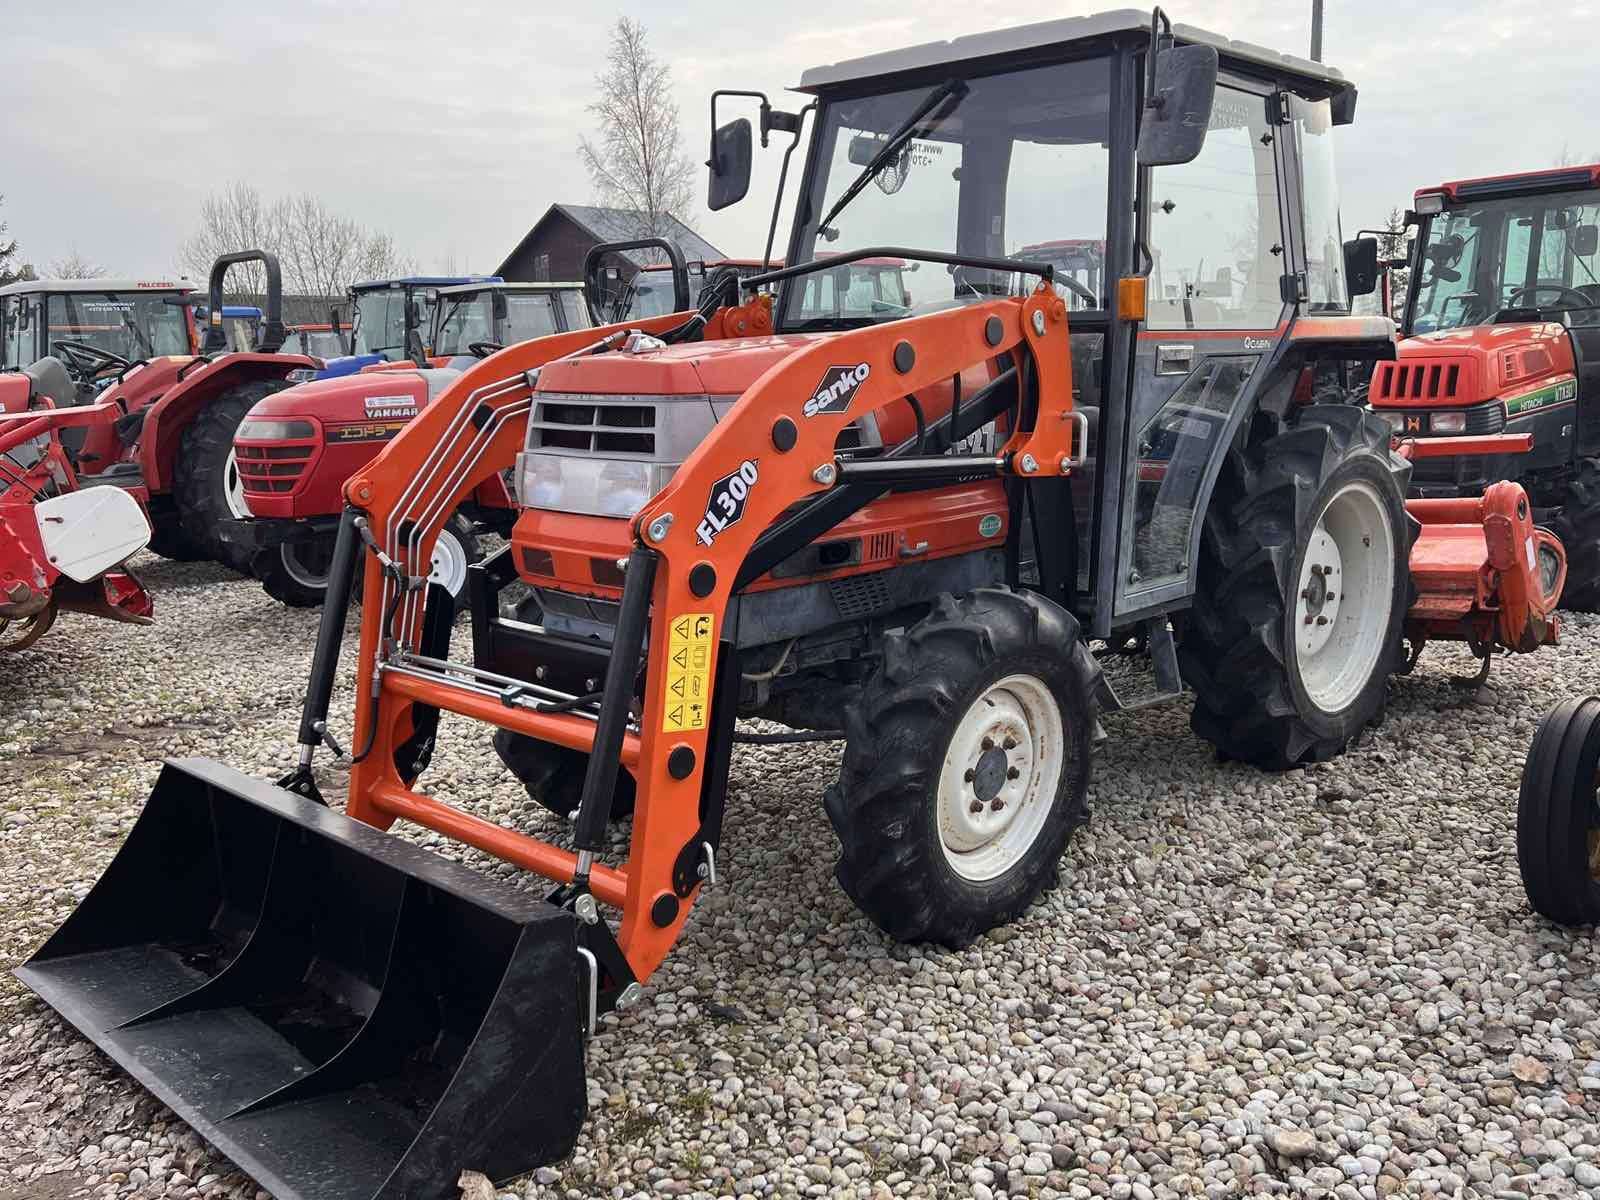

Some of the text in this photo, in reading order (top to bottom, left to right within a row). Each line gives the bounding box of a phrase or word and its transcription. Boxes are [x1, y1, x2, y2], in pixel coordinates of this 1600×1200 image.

[803, 362, 870, 418] sanko
[1520, 397, 1543, 412] HITACHI
[695, 460, 759, 547] FL300
